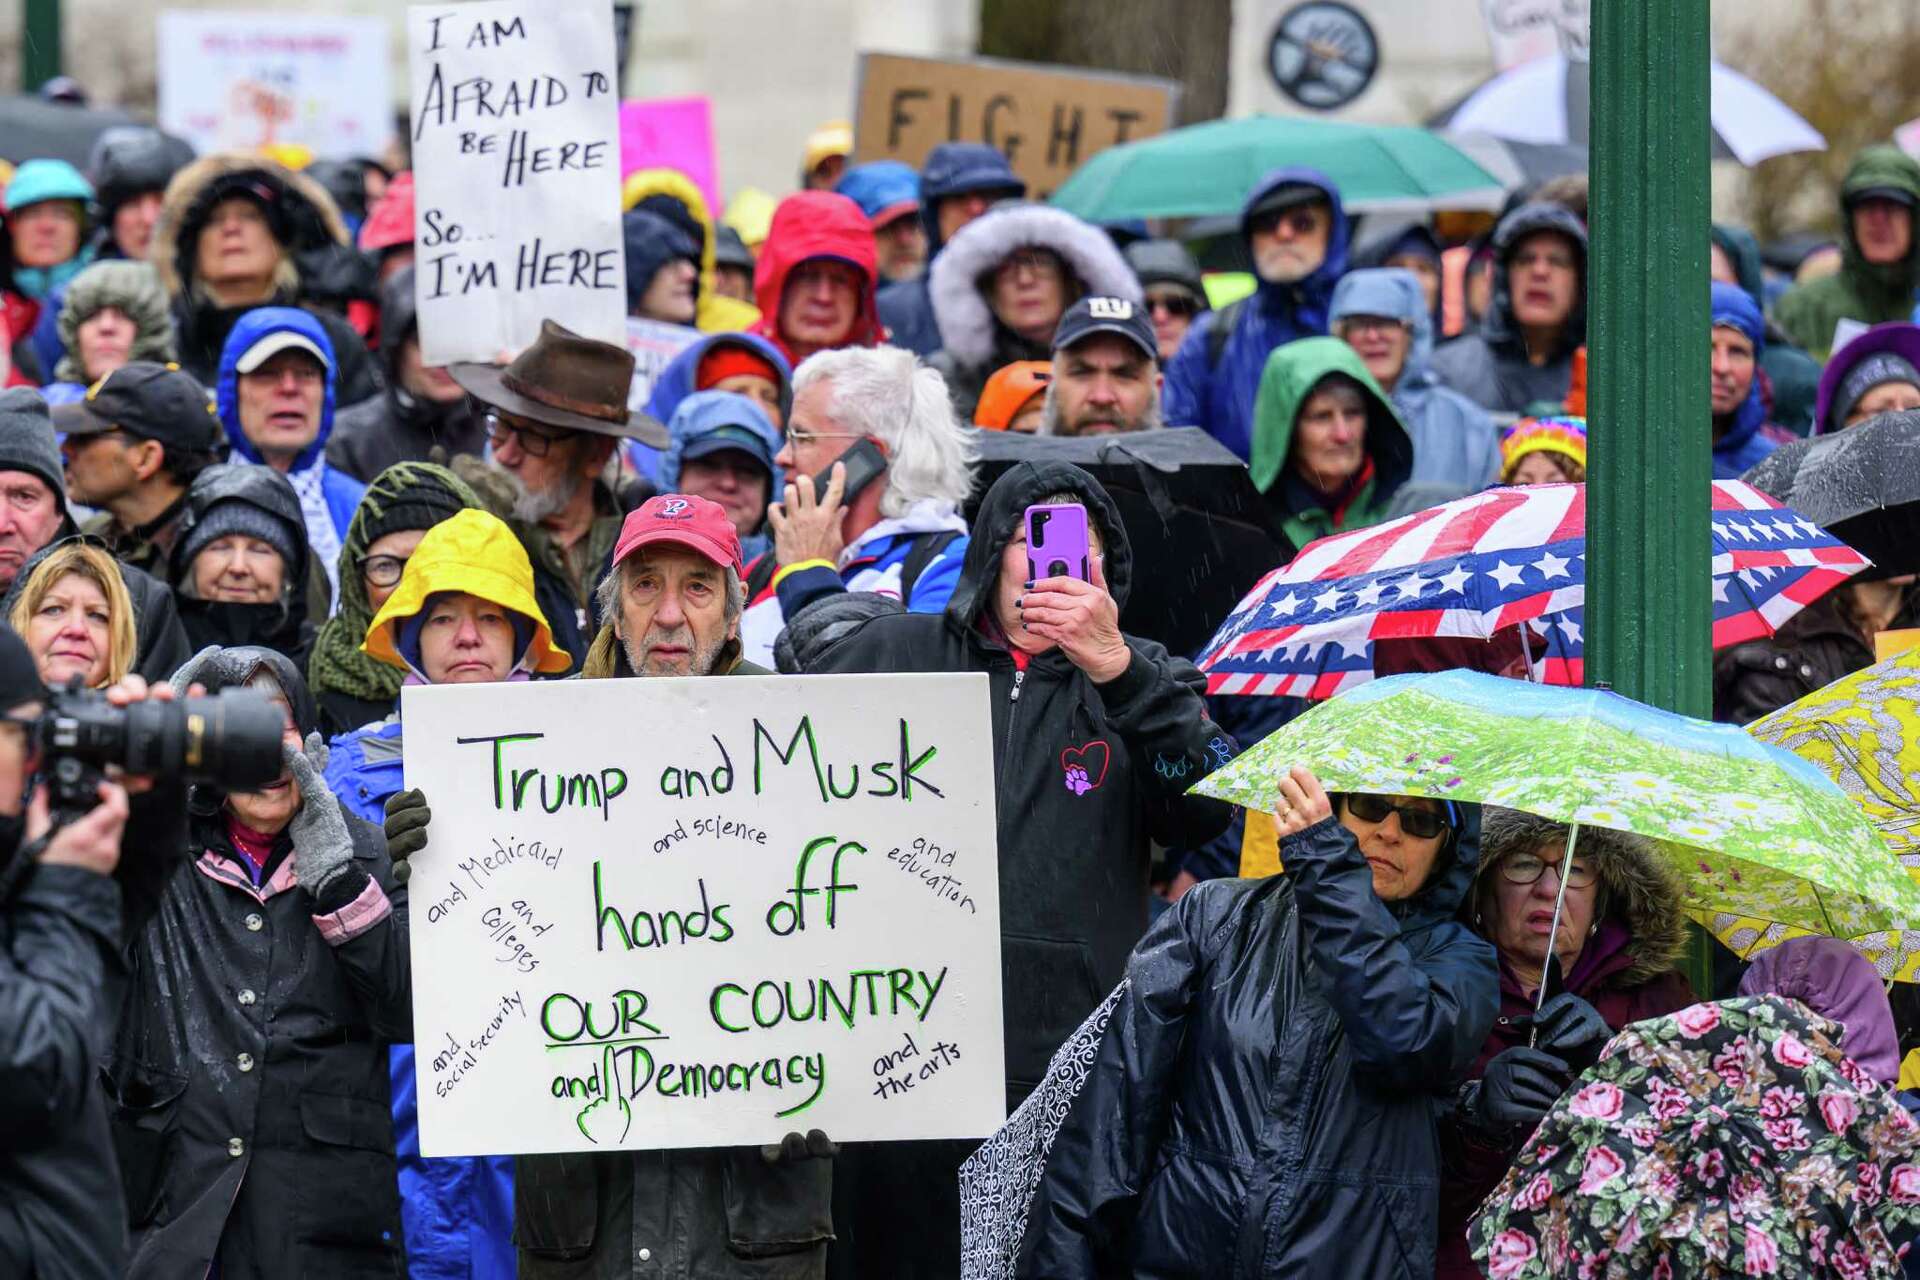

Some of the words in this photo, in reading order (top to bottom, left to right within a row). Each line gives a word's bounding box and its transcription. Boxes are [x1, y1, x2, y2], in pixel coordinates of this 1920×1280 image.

[426, 13, 457, 53] I
[466, 16, 526, 49] AM
[415, 62, 568, 141] AFRAID
[580, 71, 609, 98] TO
[887, 87, 1143, 166] FIGHT
[459, 132, 498, 154] BE
[502, 130, 608, 188] HERE
[425, 252, 497, 300] I'M
[516, 238, 618, 292] HERE
[457, 732, 628, 822] Trump
[660, 734, 734, 799] and
[753, 713, 945, 803] Musk
[653, 819, 689, 854] and
[693, 815, 768, 845] science
[913, 837, 957, 867] and
[428, 881, 468, 924] and
[458, 836, 563, 890] Medicaid
[593, 860, 734, 952] hands
[766, 836, 868, 937] off
[887, 847, 976, 915] education
[481, 907, 540, 973] Colleges
[511, 900, 554, 937] and
[541, 989, 662, 1043] OUR
[709, 967, 948, 1030] COUNTRY
[432, 1032, 463, 1074] and
[436, 1050, 478, 1099] social
[470, 990, 527, 1051] security
[873, 1033, 920, 1076] and
[873, 1076, 916, 1100] the
[919, 1041, 961, 1083] arts
[551, 1062, 602, 1100] and
[614, 1045, 826, 1118] Democracy
